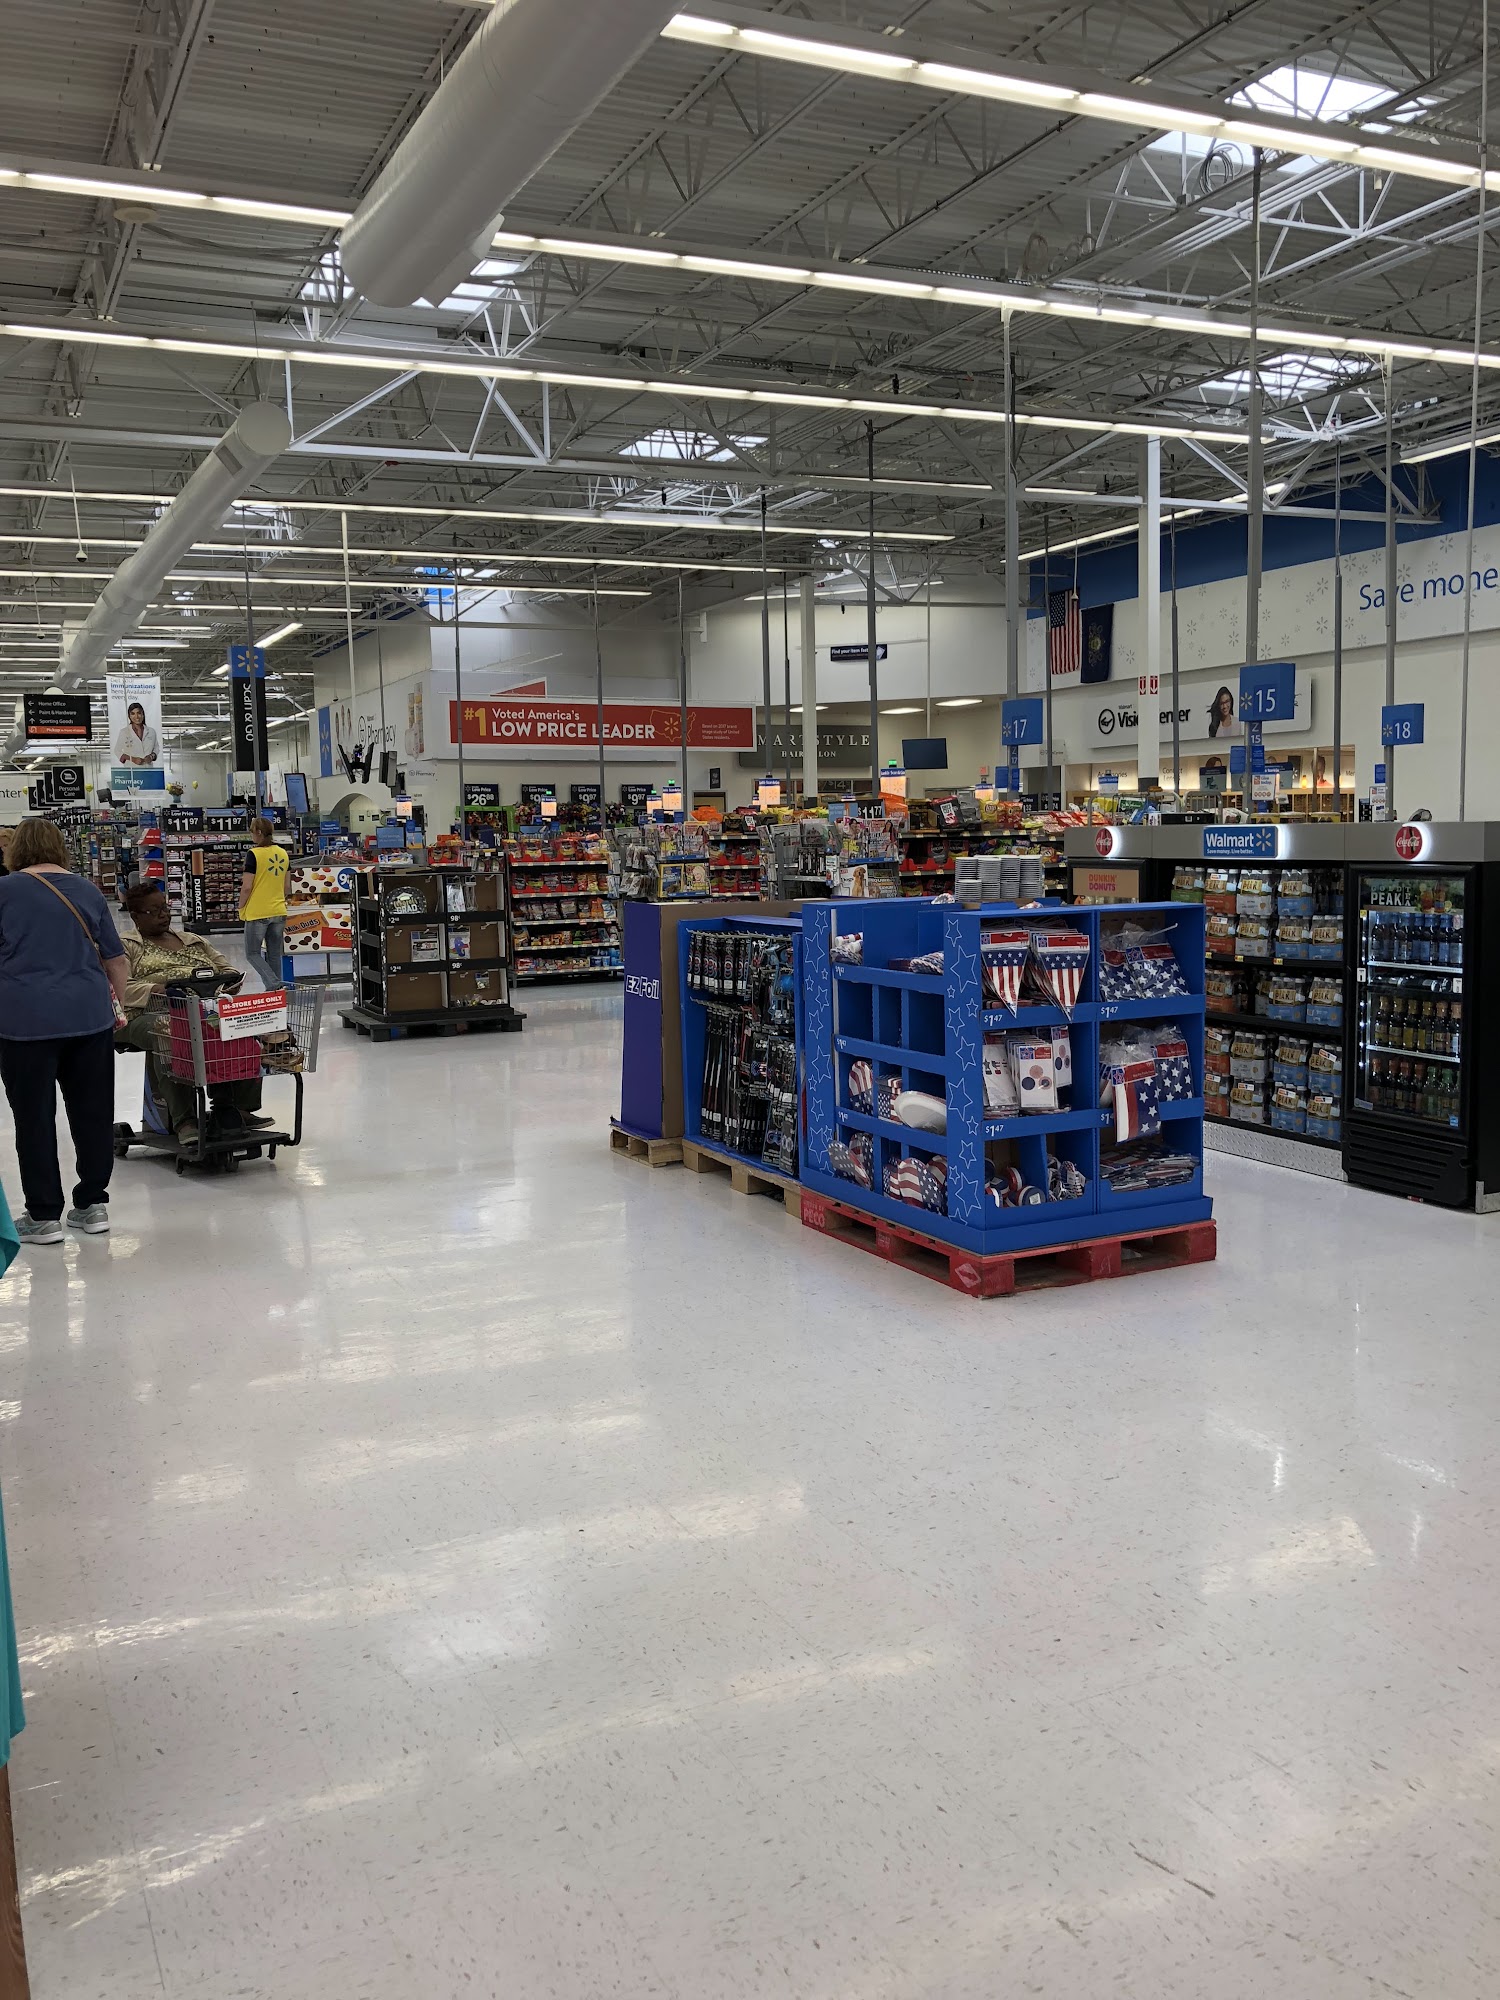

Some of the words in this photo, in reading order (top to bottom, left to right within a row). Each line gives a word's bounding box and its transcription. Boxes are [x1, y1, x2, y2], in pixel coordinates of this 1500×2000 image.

[243, 683, 252, 711] Scan
[1255, 688, 1276, 713] 15
[244, 712, 252, 723] &
[492, 707, 525, 720] Voted
[527, 709, 580, 721] America's
[1117, 711, 1139, 728] Visi
[1159, 709, 1191, 724] ener
[464, 707, 487, 737] #1
[1013, 719, 1028, 739] 17
[1252, 723, 1259, 733] Z
[245, 724, 254, 742] Go
[492, 721, 532, 737] LOW
[537, 723, 588, 738] PRICE
[592, 724, 656, 740] LEADER
[1394, 721, 1411, 739] 18
[1251, 735, 1261, 744] 15
[115, 778, 144, 786] Pharmacy
[1205, 832, 1254, 848] Walmart
[1088, 873, 1118, 883] DUNKIN'
[1088, 882, 1116, 892] DONUTS
[1371, 885, 1402, 893] GOLD
[193, 878, 203, 920] DURACELL
[1370, 892, 1402, 906] PEAK
[396, 904, 418, 914] GRAD
[284, 924, 300, 933] Milk
[300, 918, 321, 929] Duds
[625, 974, 640, 995] EZ
[638, 976, 660, 1000] Foil
[222, 1000, 252, 1010] IN-STORE
[252, 998, 265, 1006] USE
[265, 995, 283, 1003] ONLY
[1100, 1006, 1119, 1018] $147
[983, 1014, 1003, 1027] $147
[1100, 1112, 1114, 1125] $14
[985, 1124, 1004, 1136] $147
[803, 1207, 826, 1228] PECO
